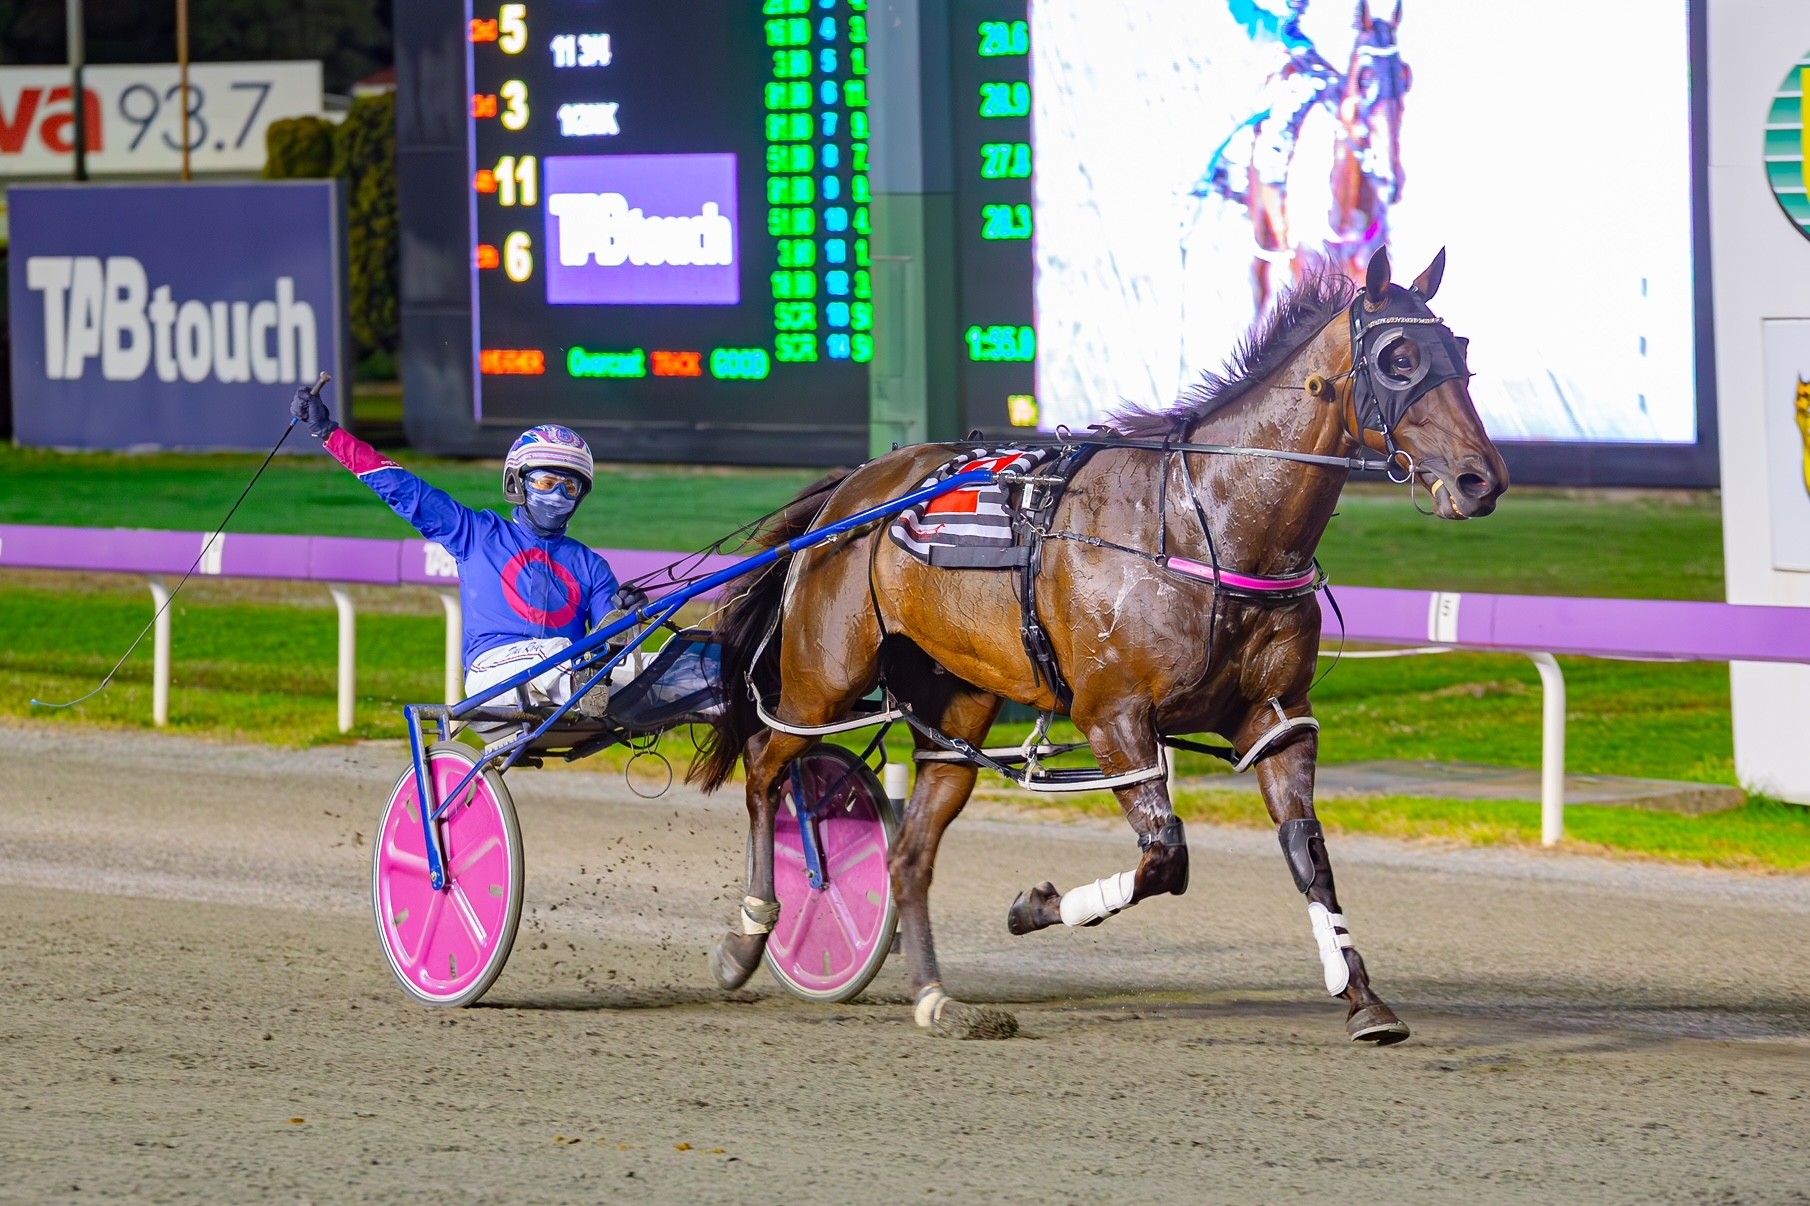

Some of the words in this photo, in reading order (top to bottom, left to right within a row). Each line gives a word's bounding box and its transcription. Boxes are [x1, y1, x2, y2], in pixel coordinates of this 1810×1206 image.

[498, 3, 528, 55] 5
[118, 81, 275, 152] 93.7
[500, 79, 530, 131] 3
[821, 111, 838, 136] 7
[492, 155, 538, 207] 11
[549, 192, 733, 267] TABtouch
[503, 230, 533, 282] 6
[26, 256, 318, 384] TABtouch
